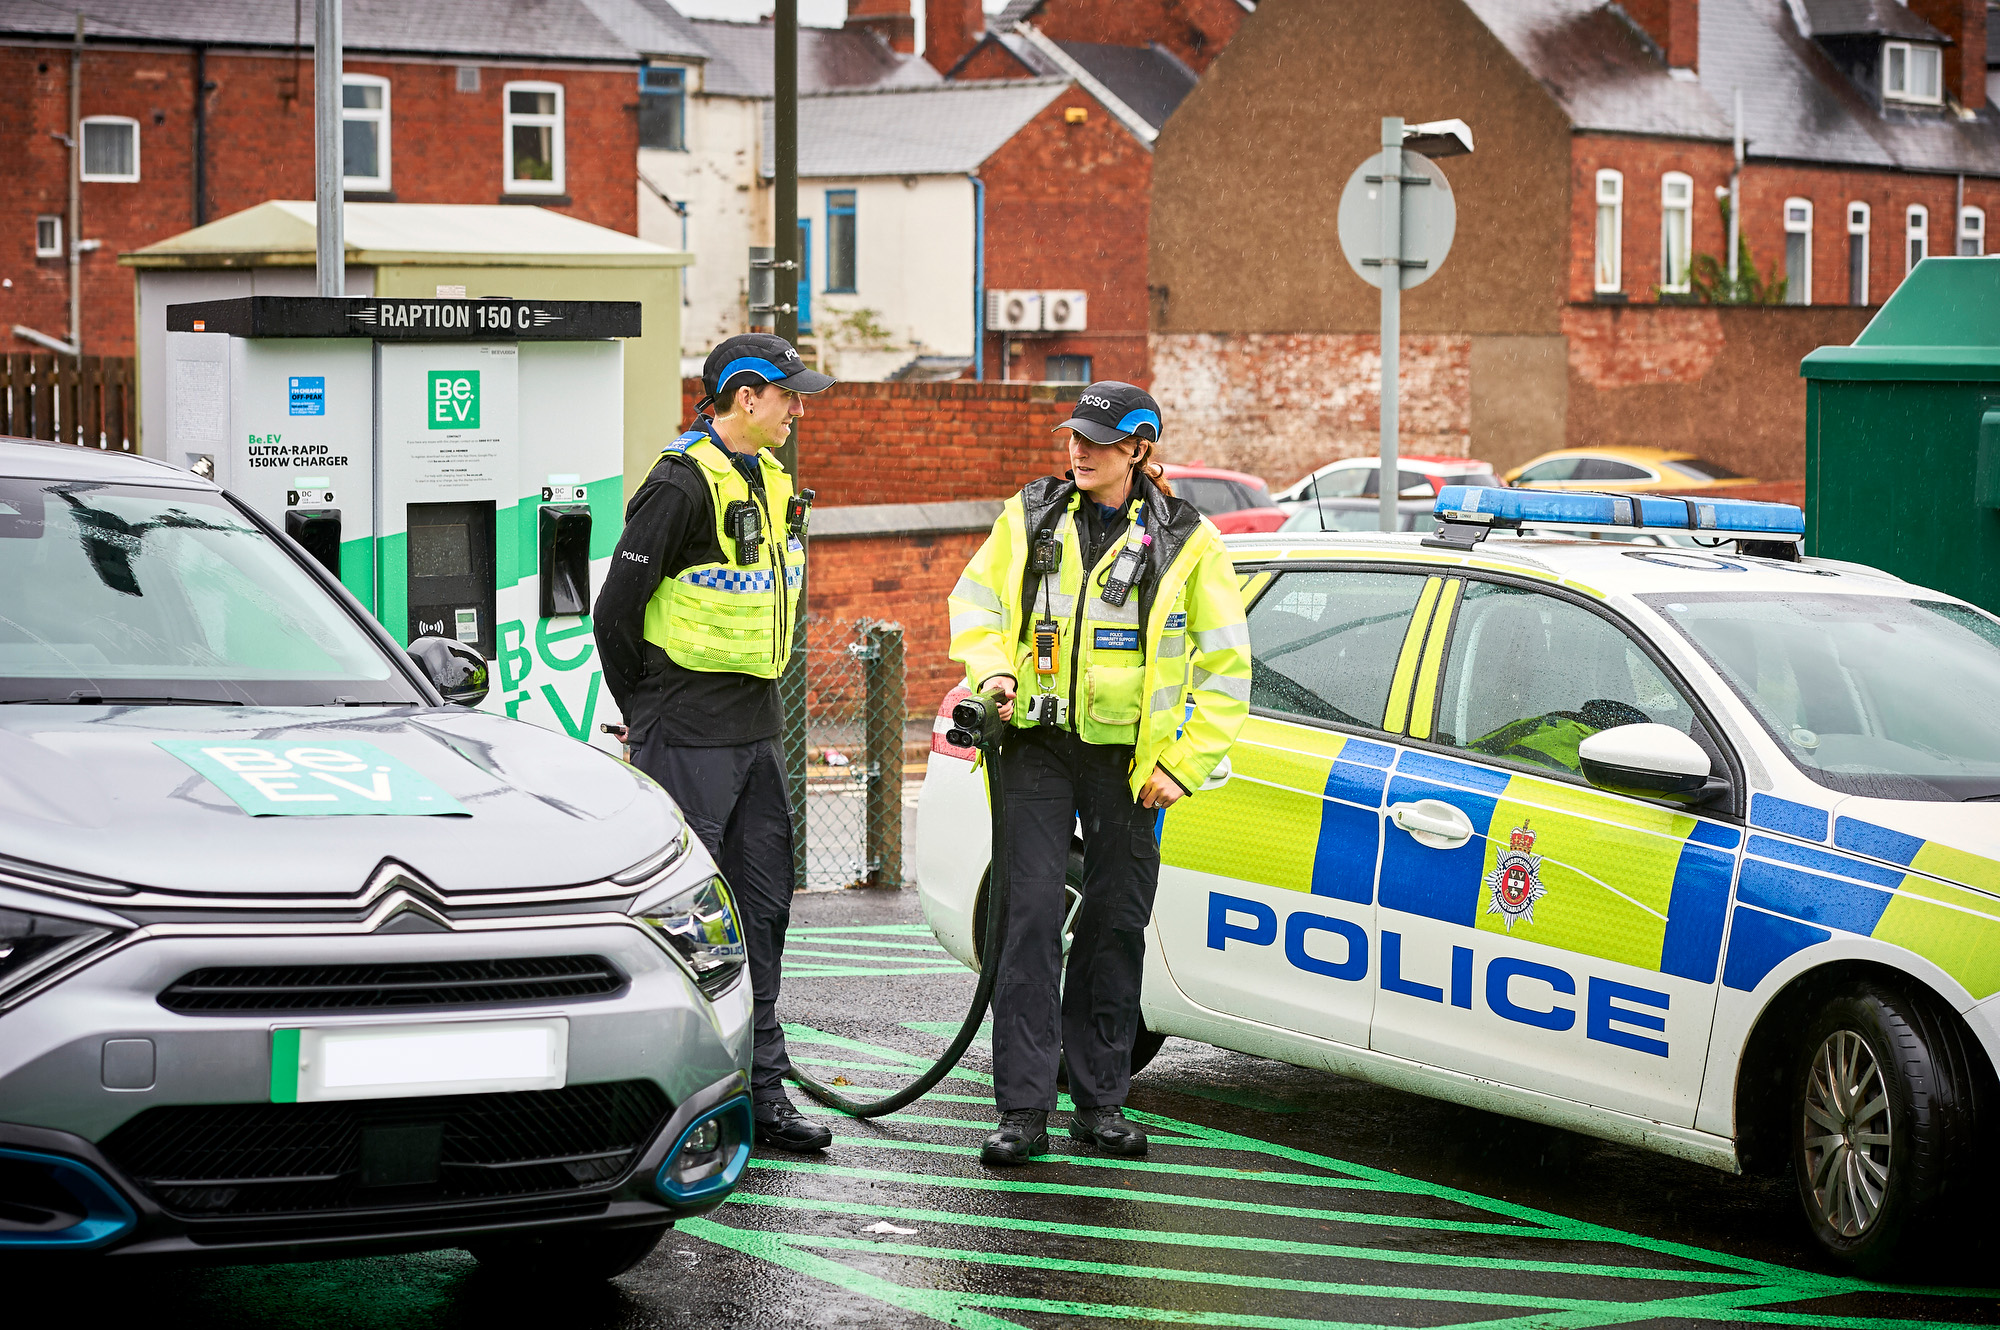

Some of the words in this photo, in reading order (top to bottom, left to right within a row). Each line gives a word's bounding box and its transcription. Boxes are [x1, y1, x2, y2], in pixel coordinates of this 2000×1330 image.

[381, 304, 470, 328] RAPTION
[476, 305, 512, 329] 150
[517, 306, 530, 329] C
[1079, 394, 1111, 410] PCSO
[435, 400, 472, 422] EV
[248, 434, 282, 444] Be.EV
[248, 445, 329, 456] ULTRA-RAPID
[248, 457, 290, 468] 150KW
[292, 456, 349, 467] CHARGER
[290, 494, 295, 503] 1
[543, 490, 549, 499] 2
[621, 550, 650, 564] POLICE
[237, 771, 393, 802] EV
[1206, 890, 1671, 1059] POLICE
